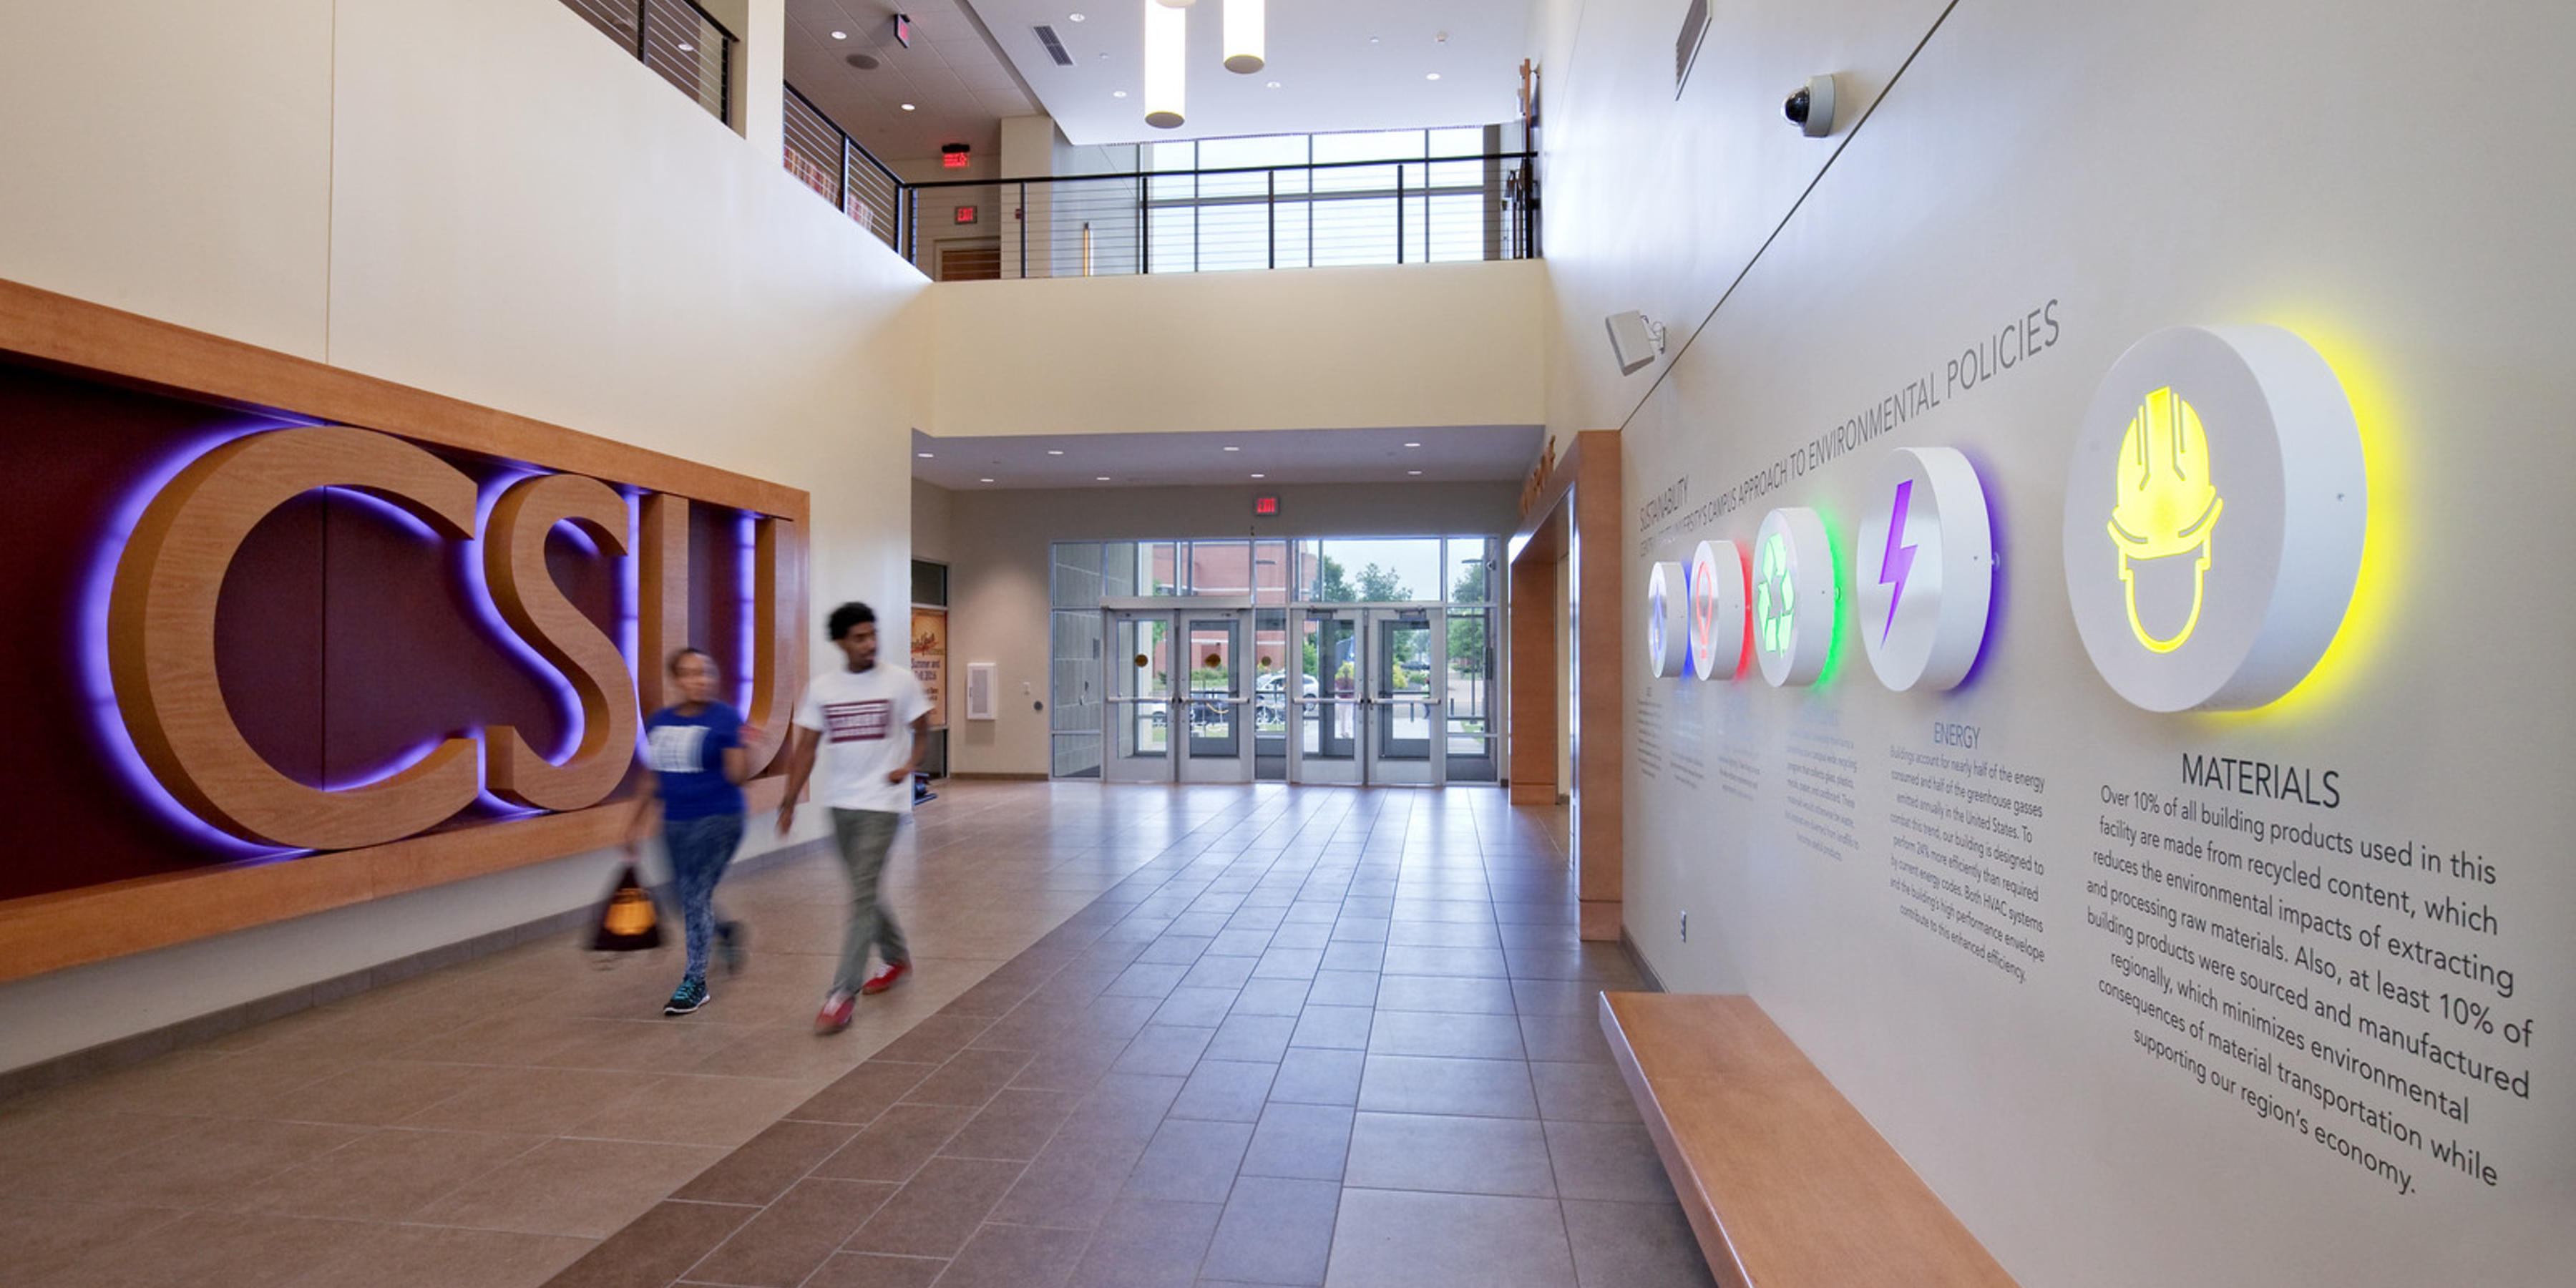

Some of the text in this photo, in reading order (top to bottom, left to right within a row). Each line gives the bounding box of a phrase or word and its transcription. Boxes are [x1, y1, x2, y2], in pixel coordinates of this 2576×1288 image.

[1708, 487, 1737, 522] CAMPUS
[1739, 457, 1787, 507] APPROACH
[1791, 445, 1807, 479] TO
[1809, 369, 1940, 471] ENVIRONMENTAL
[1946, 298, 2060, 400] POLICIES
[1257, 497, 1276, 513] EXIT
[109, 427, 794, 849] CSU
[1934, 722, 1980, 749] ENERGY
[1921, 776, 1931, 788] and
[1933, 777, 1944, 791] half
[1946, 781, 1954, 794] of
[1954, 782, 1965, 797] the
[1967, 789, 2011, 809] greenhouse
[2014, 801, 2042, 818] gasses
[1941, 754, 1950, 769] for
[1951, 759, 1971, 778] nearly
[1974, 761, 1987, 776] half
[1989, 765, 1996, 779] of
[1999, 766, 2012, 782] the
[2014, 774, 2044, 794] energy
[2182, 753, 2340, 808] MATERIALS
[1919, 801, 1943, 820] annually
[1946, 804, 1951, 818] in
[1953, 806, 1963, 821] the
[1966, 810, 1990, 829] United
[1992, 817, 2019, 839] States.
[2021, 826, 2032, 842] To
[1923, 821, 1941, 844] trend,
[1943, 831, 1953, 843] our
[1956, 831, 1984, 859] building
[1985, 841, 1991, 857] is
[1993, 844, 2032, 872] designed
[2034, 859, 2044, 876] to
[2101, 784, 2496, 884] Over 10% of all building products used in this
[1917, 842, 1928, 858] 24%
[1931, 852, 1946, 865] more
[1948, 855, 1981, 884] efficiently
[1983, 867, 1999, 886] than
[2002, 879, 2038, 902] required
[1920, 869, 1940, 891] energy
[1941, 878, 1962, 896] codes.
[1964, 885, 1982, 904] Both
[1984, 893, 2006, 916] HVAC
[2009, 909, 2043, 932] systems
[2099, 816, 2497, 935] facility are made from recycled content, which
[1930, 917, 1937, 932] to
[1938, 921, 1950, 939] this
[1951, 932, 1984, 957] enhanced
[1987, 949, 2026, 985] efficiency.
[1941, 899, 1955, 920] high
[1956, 910, 2002, 942] performance
[2004, 935, 2044, 965] envelope
[2093, 848, 2514, 1001] reduces the environmental impacts of extracting
[2087, 878, 2533, 1049] and processing raw materials. Also, at least 10% of
[2087, 906, 2529, 1099] building products were sourced and manufactured
[2111, 951, 2468, 1124] regionally, which minimizes environmental
[2099, 978, 2497, 1186] consequences of material transportation while
[2134, 1028, 2205, 1085] supporting
[2211, 1069, 2235, 1095] our
[2315, 1124, 2415, 1197] economy.
